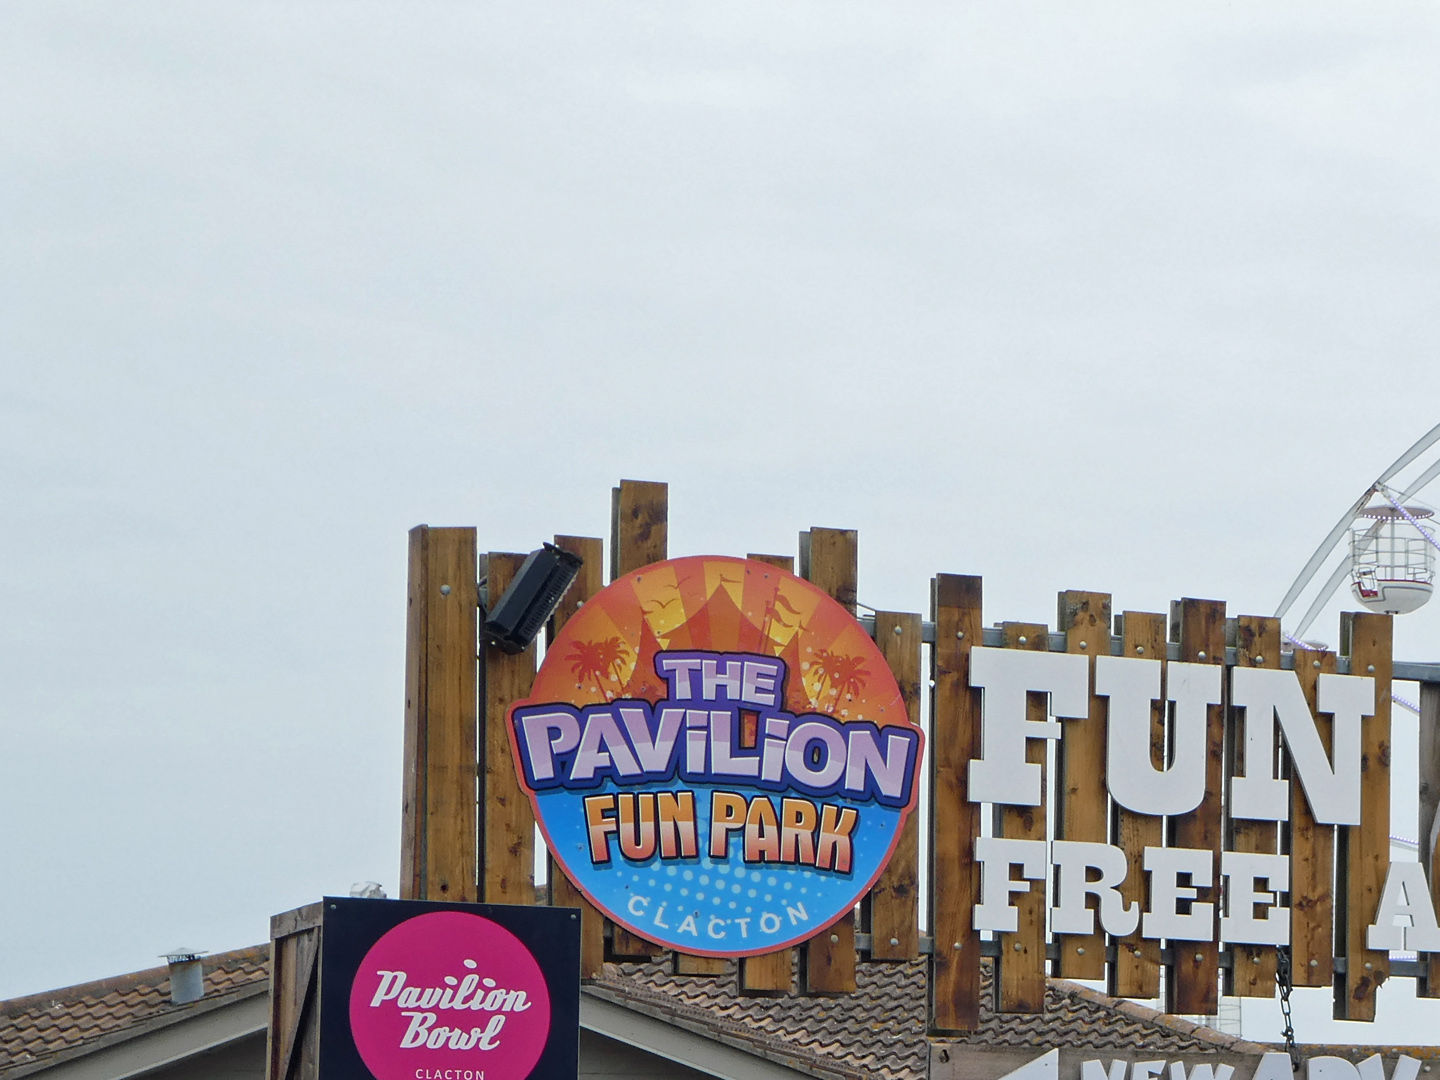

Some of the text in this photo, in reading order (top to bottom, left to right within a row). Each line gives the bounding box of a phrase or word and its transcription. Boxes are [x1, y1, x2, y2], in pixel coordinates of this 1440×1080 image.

[661, 658, 778, 706] THE
[967, 646, 1376, 826] FUN
[584, 792, 858, 873] FUN PARK
[972, 836, 1290, 946] FREE
[628, 896, 809, 939] CLACTON
[370, 959, 532, 1012] Pavilion
[400, 1012, 506, 1050] Bowl
[415, 1069, 485, 1080] CLACTON
